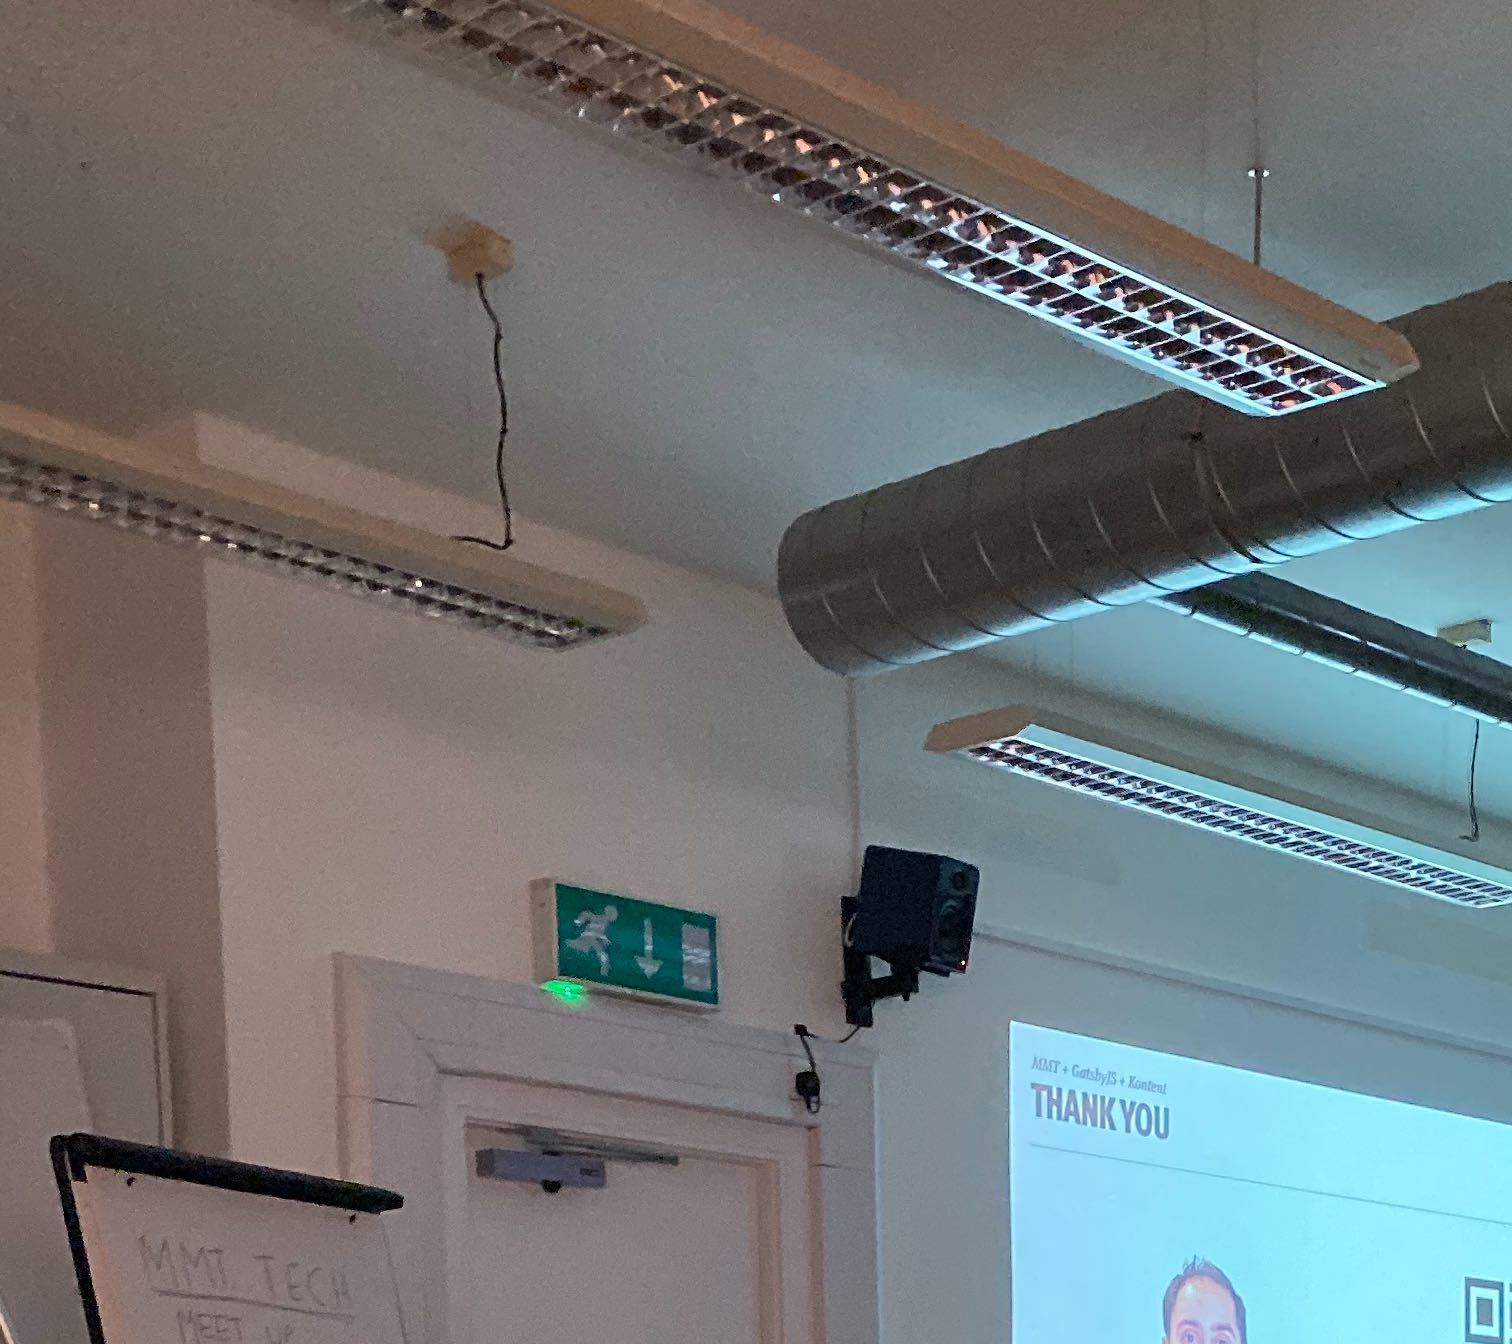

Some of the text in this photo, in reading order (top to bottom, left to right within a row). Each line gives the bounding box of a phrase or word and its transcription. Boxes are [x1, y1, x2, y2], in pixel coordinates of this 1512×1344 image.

[1032, 1056, 1061, 1074] MMT
[1071, 1064, 1117, 1086] GatsbyJS
[1128, 1075, 1167, 1095] Kontent
[1030, 1082, 1170, 1140] THANK YOU
[139, 1234, 348, 1307] MMT TECH
